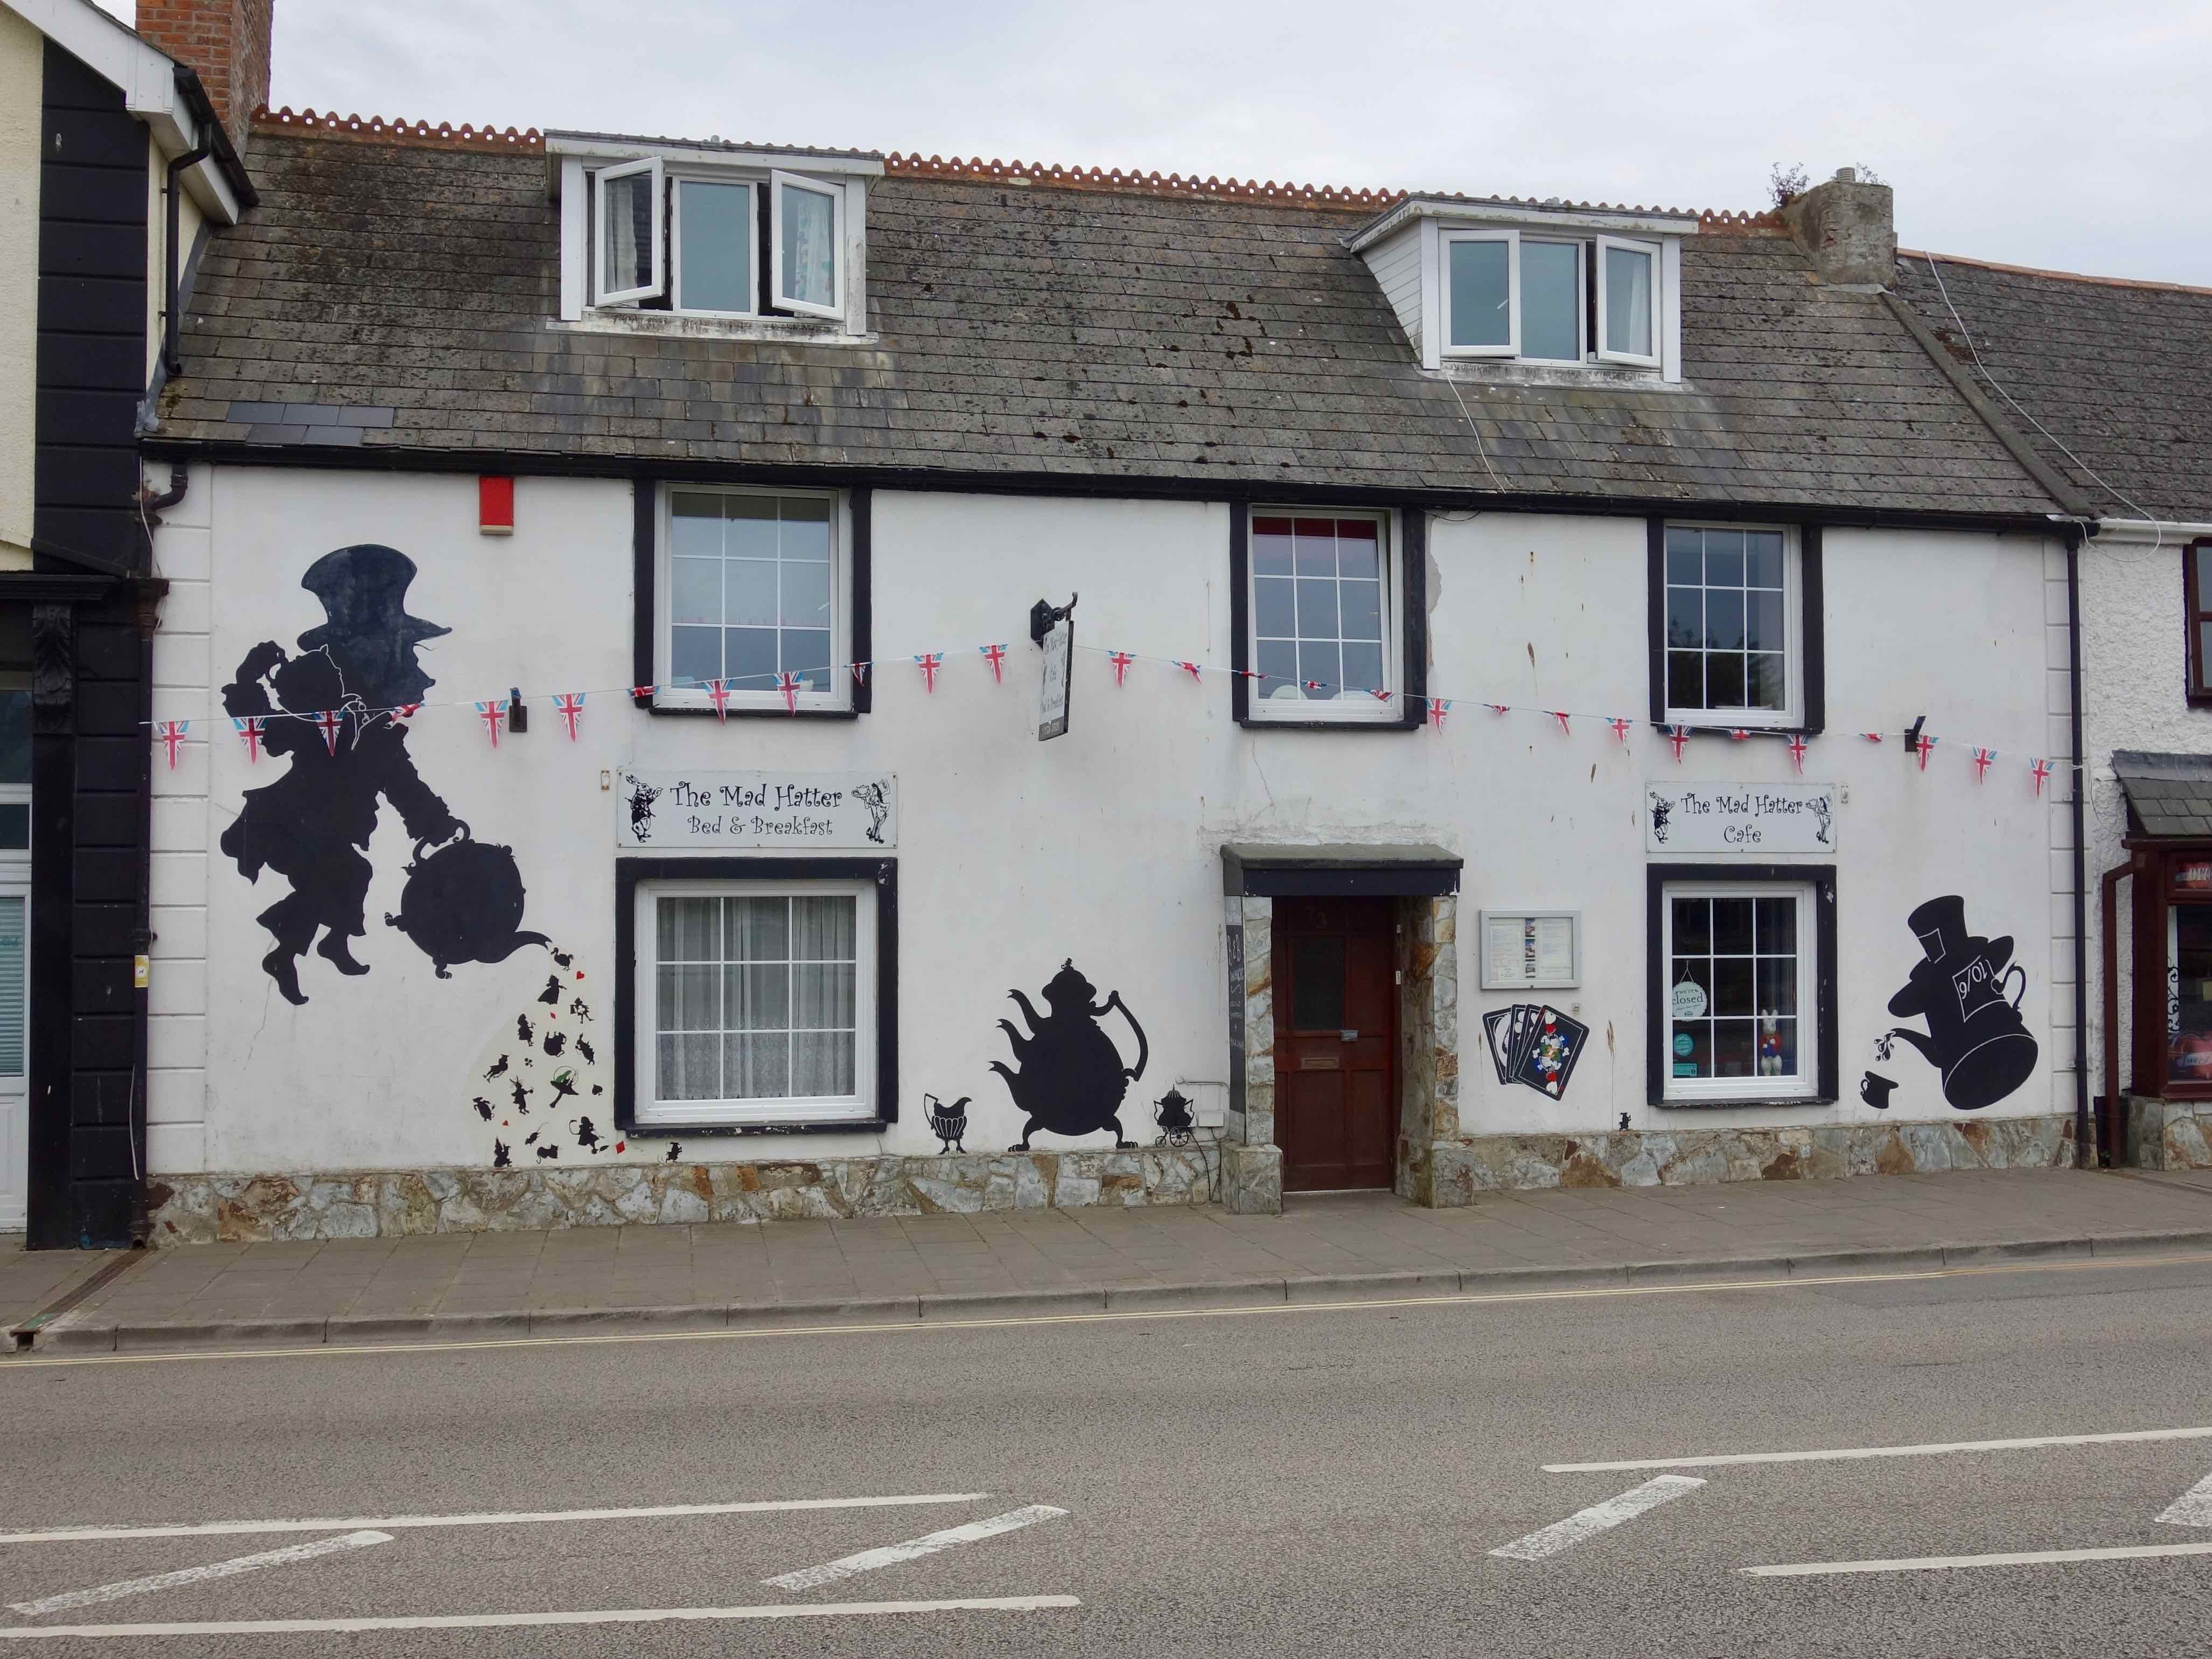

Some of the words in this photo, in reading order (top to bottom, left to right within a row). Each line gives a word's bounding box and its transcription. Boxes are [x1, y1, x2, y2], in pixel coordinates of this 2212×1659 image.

[669, 780, 711, 807] The
[719, 783, 767, 807] Mad
[774, 784, 842, 812] Hatter
[1680, 792, 1711, 814] The
[1715, 793, 1750, 814] Mad
[1754, 794, 1803, 818] Hatter
[687, 815, 722, 834] Bed
[729, 816, 746, 835] &
[750, 815, 833, 836] Breakfast
[1723, 824, 1762, 844] Cafe
[1672, 992, 1703, 1005] closed
